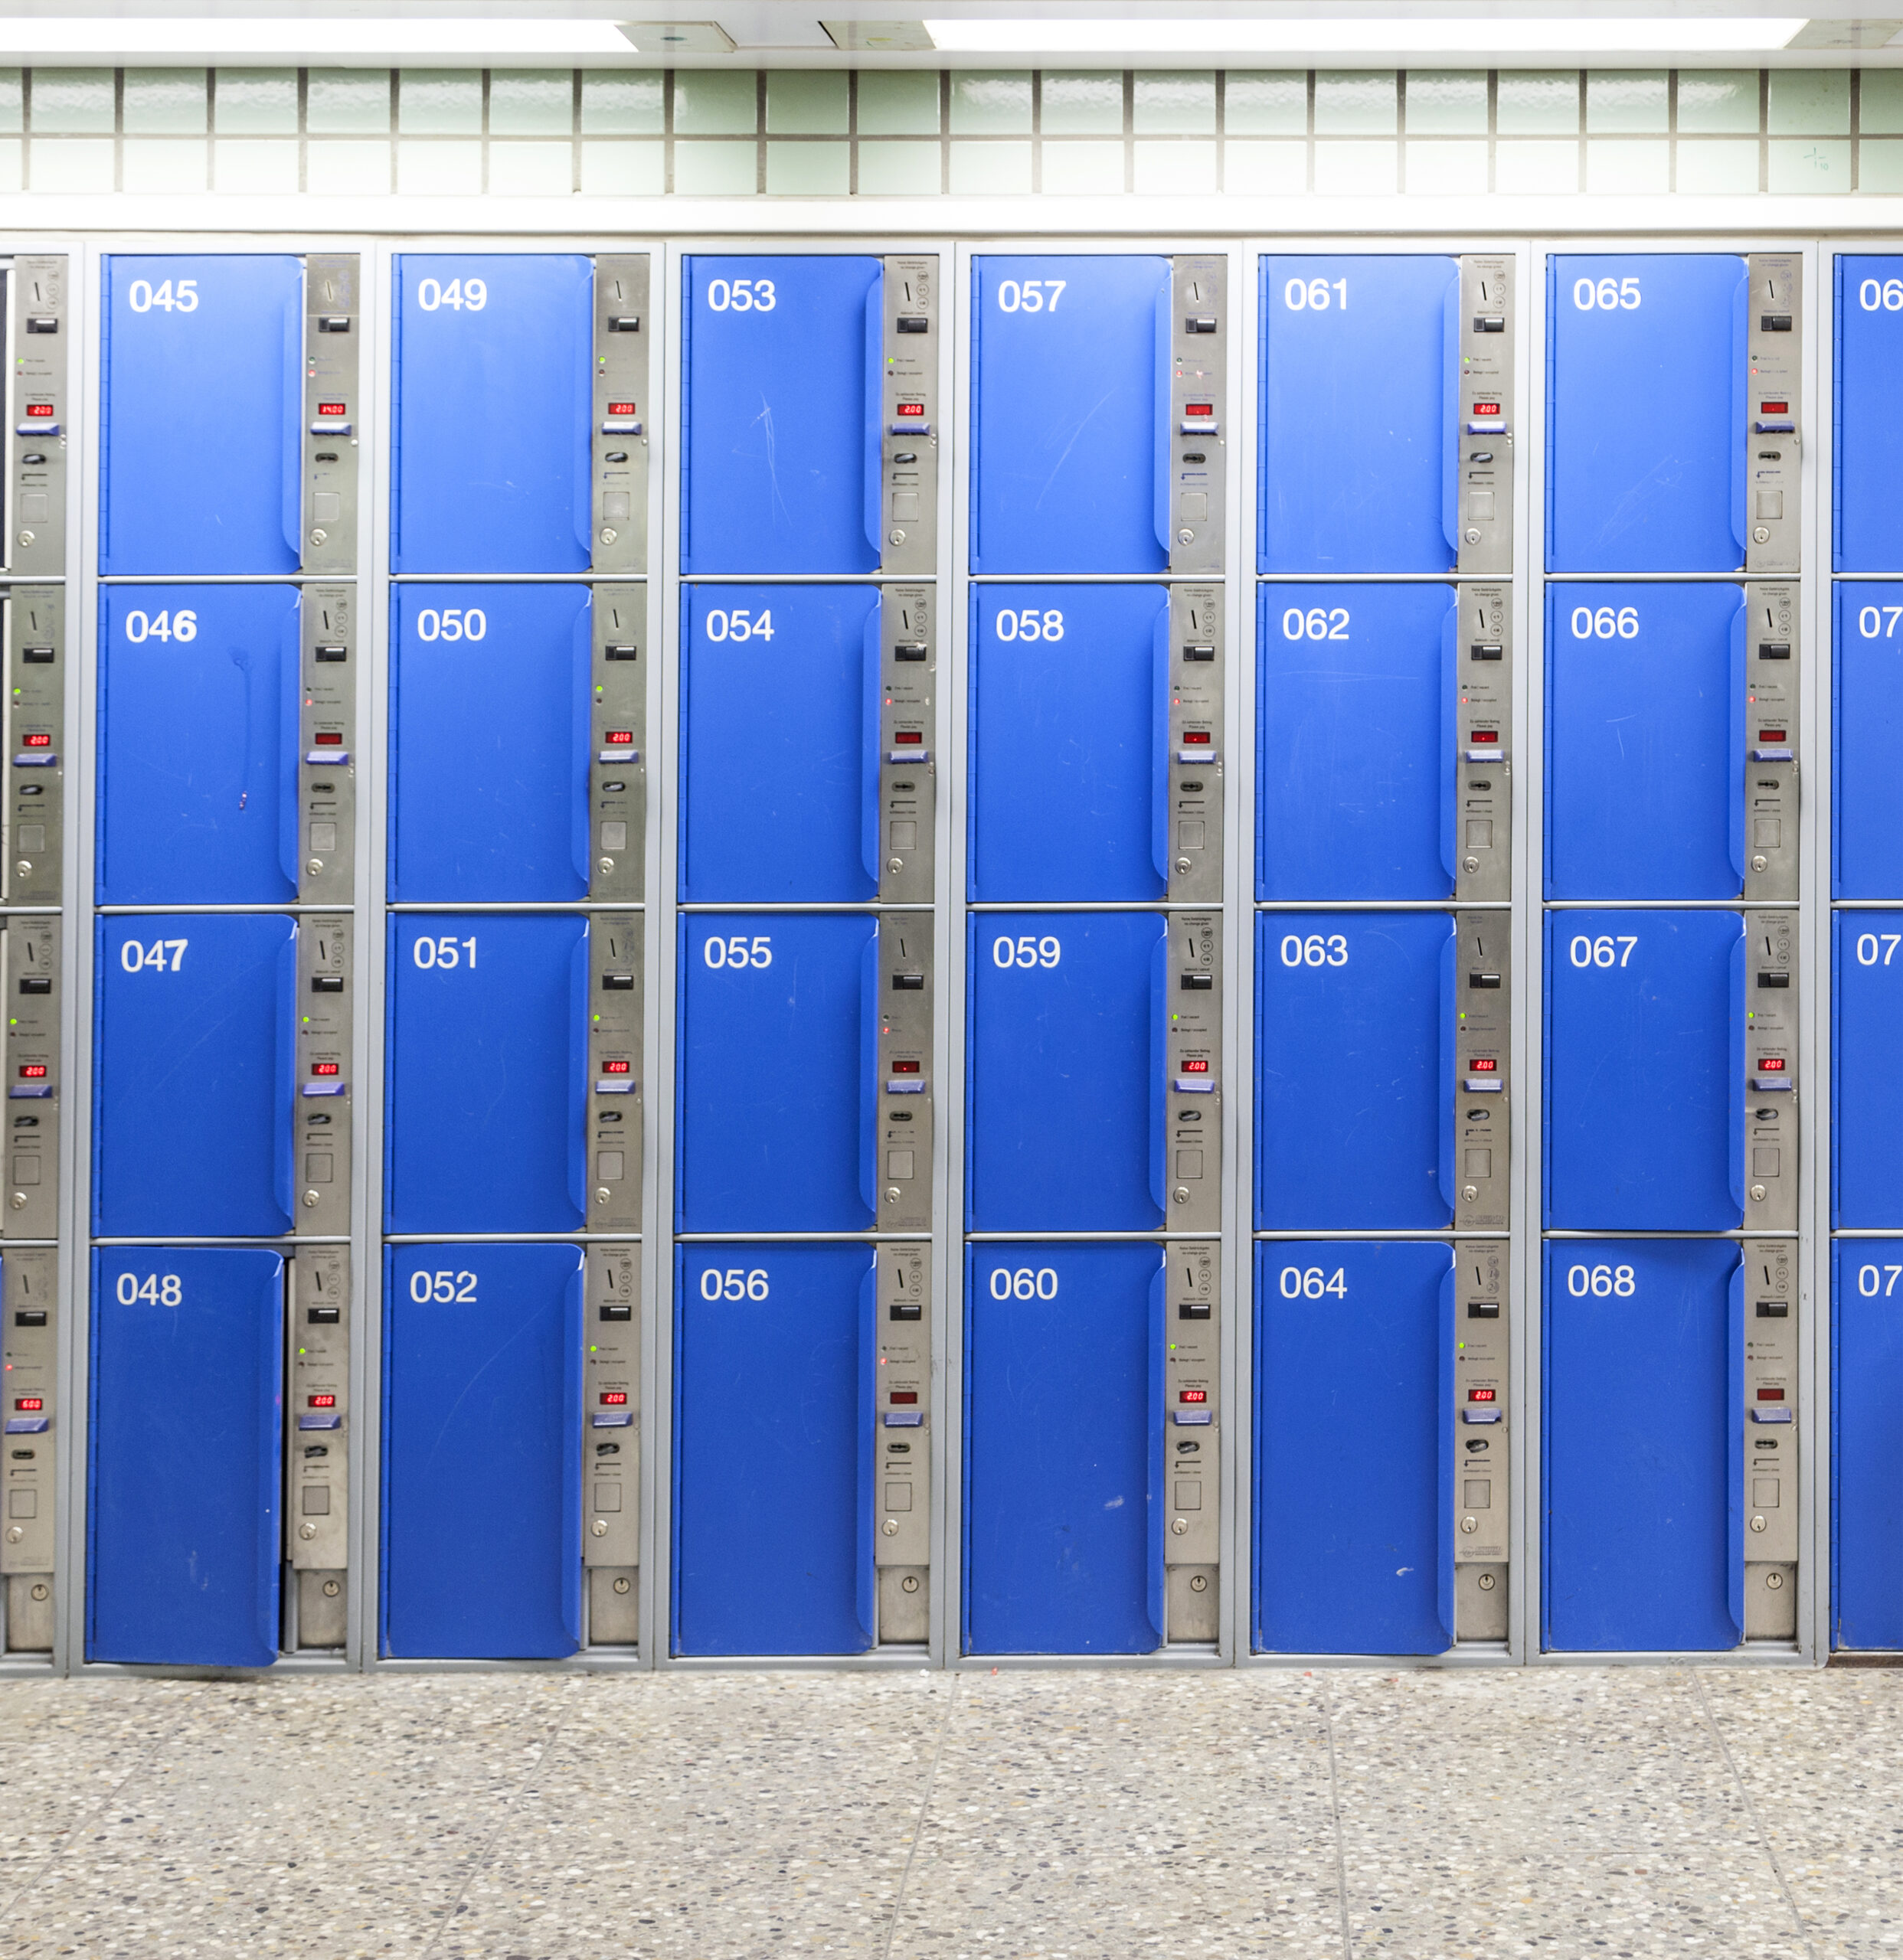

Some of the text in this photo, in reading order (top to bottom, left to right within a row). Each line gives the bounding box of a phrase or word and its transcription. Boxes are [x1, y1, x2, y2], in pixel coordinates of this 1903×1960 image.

[128, 278, 200, 314] 045
[417, 277, 489, 312] 049
[707, 278, 777, 312] 053
[997, 279, 1068, 314] 057
[1283, 276, 1348, 312] 061
[1572, 276, 1643, 312] 065
[125, 609, 198, 643] 046
[417, 608, 487, 642] 050
[705, 609, 775, 642] 054
[996, 609, 1064, 642] 058
[1282, 607, 1350, 641] 062
[1571, 606, 1640, 639] 066
[121, 939, 188, 972] 047
[414, 936, 476, 969] 051
[704, 936, 773, 969] 055
[992, 936, 1061, 969] 059
[1280, 934, 1349, 967] 063
[1570, 935, 1638, 968] 067
[116, 1272, 181, 1307] 048
[410, 1270, 477, 1303] 052
[700, 1269, 769, 1302] 056
[989, 1268, 1058, 1301] 060
[1280, 1266, 1348, 1299] 064
[1568, 1264, 1636, 1297] 068
